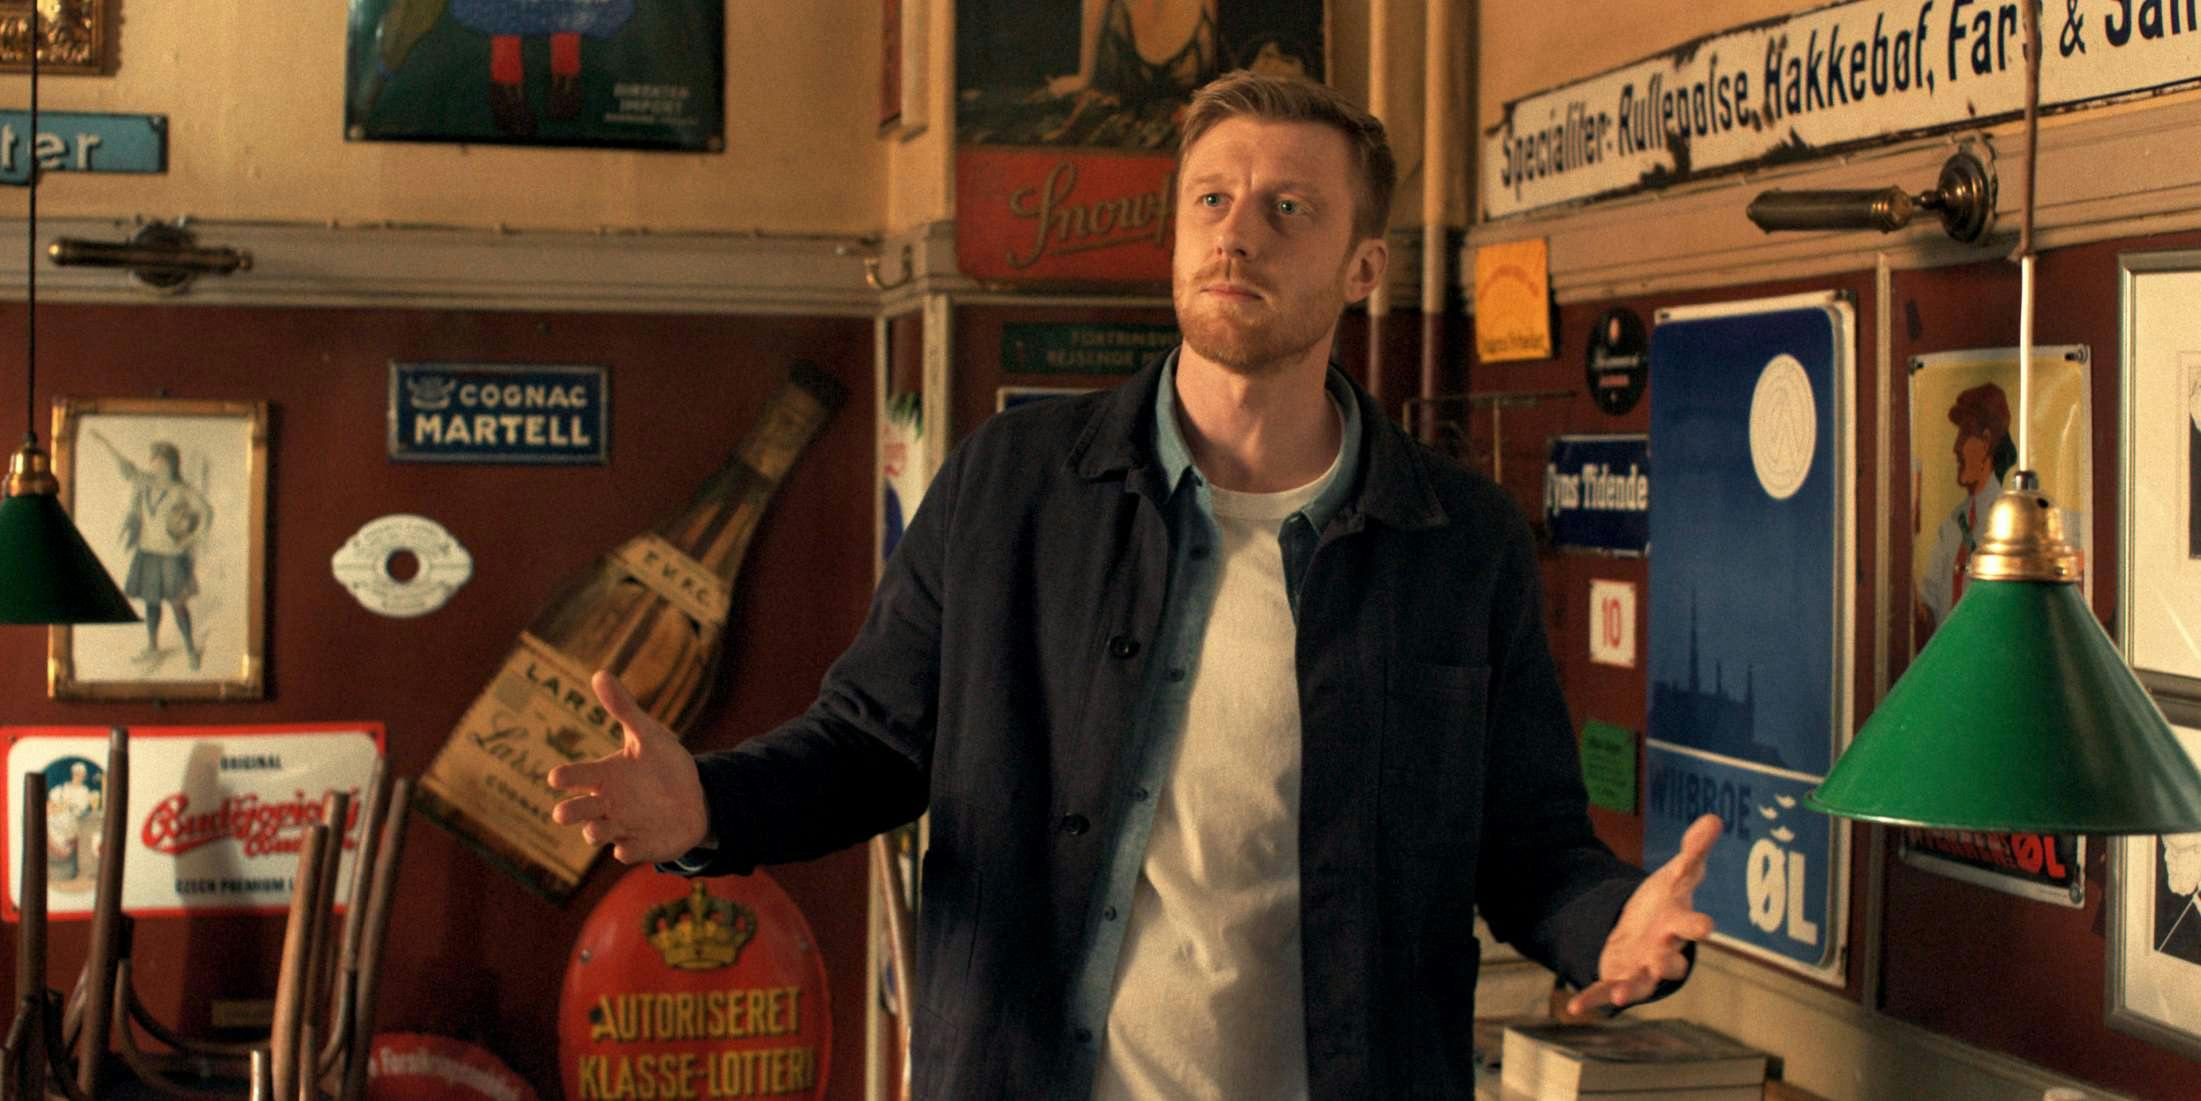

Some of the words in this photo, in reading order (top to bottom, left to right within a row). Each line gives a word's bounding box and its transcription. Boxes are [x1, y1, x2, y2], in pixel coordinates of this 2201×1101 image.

[1948, 0, 2043, 81] Far
[2059, 0, 2086, 57] &
[459, 384, 588, 407] COGNAC
[414, 413, 590, 446] MARTELL
[1602, 597, 1622, 648] 10
[525, 662, 625, 746] LARSE
[1746, 838, 1818, 946] ØL
[591, 987, 802, 1043] AUTORISERET
